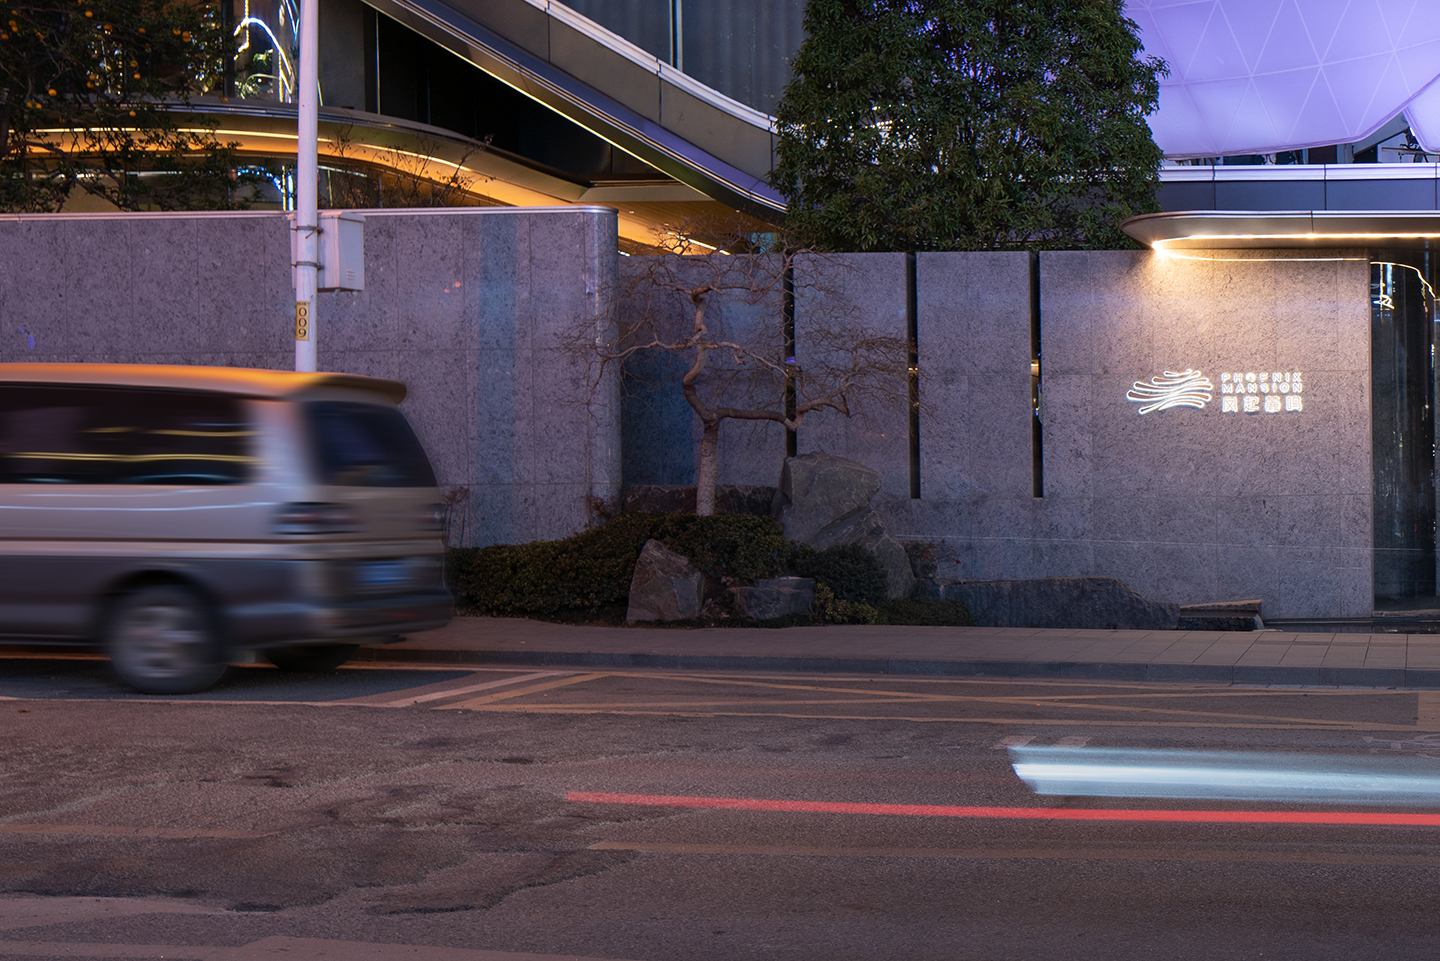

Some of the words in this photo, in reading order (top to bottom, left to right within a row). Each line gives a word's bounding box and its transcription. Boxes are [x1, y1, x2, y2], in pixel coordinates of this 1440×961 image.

[298, 307, 307, 337] 009
[1220, 372, 1302, 382] PHOENIX
[1221, 382, 1302, 393] MANSION
